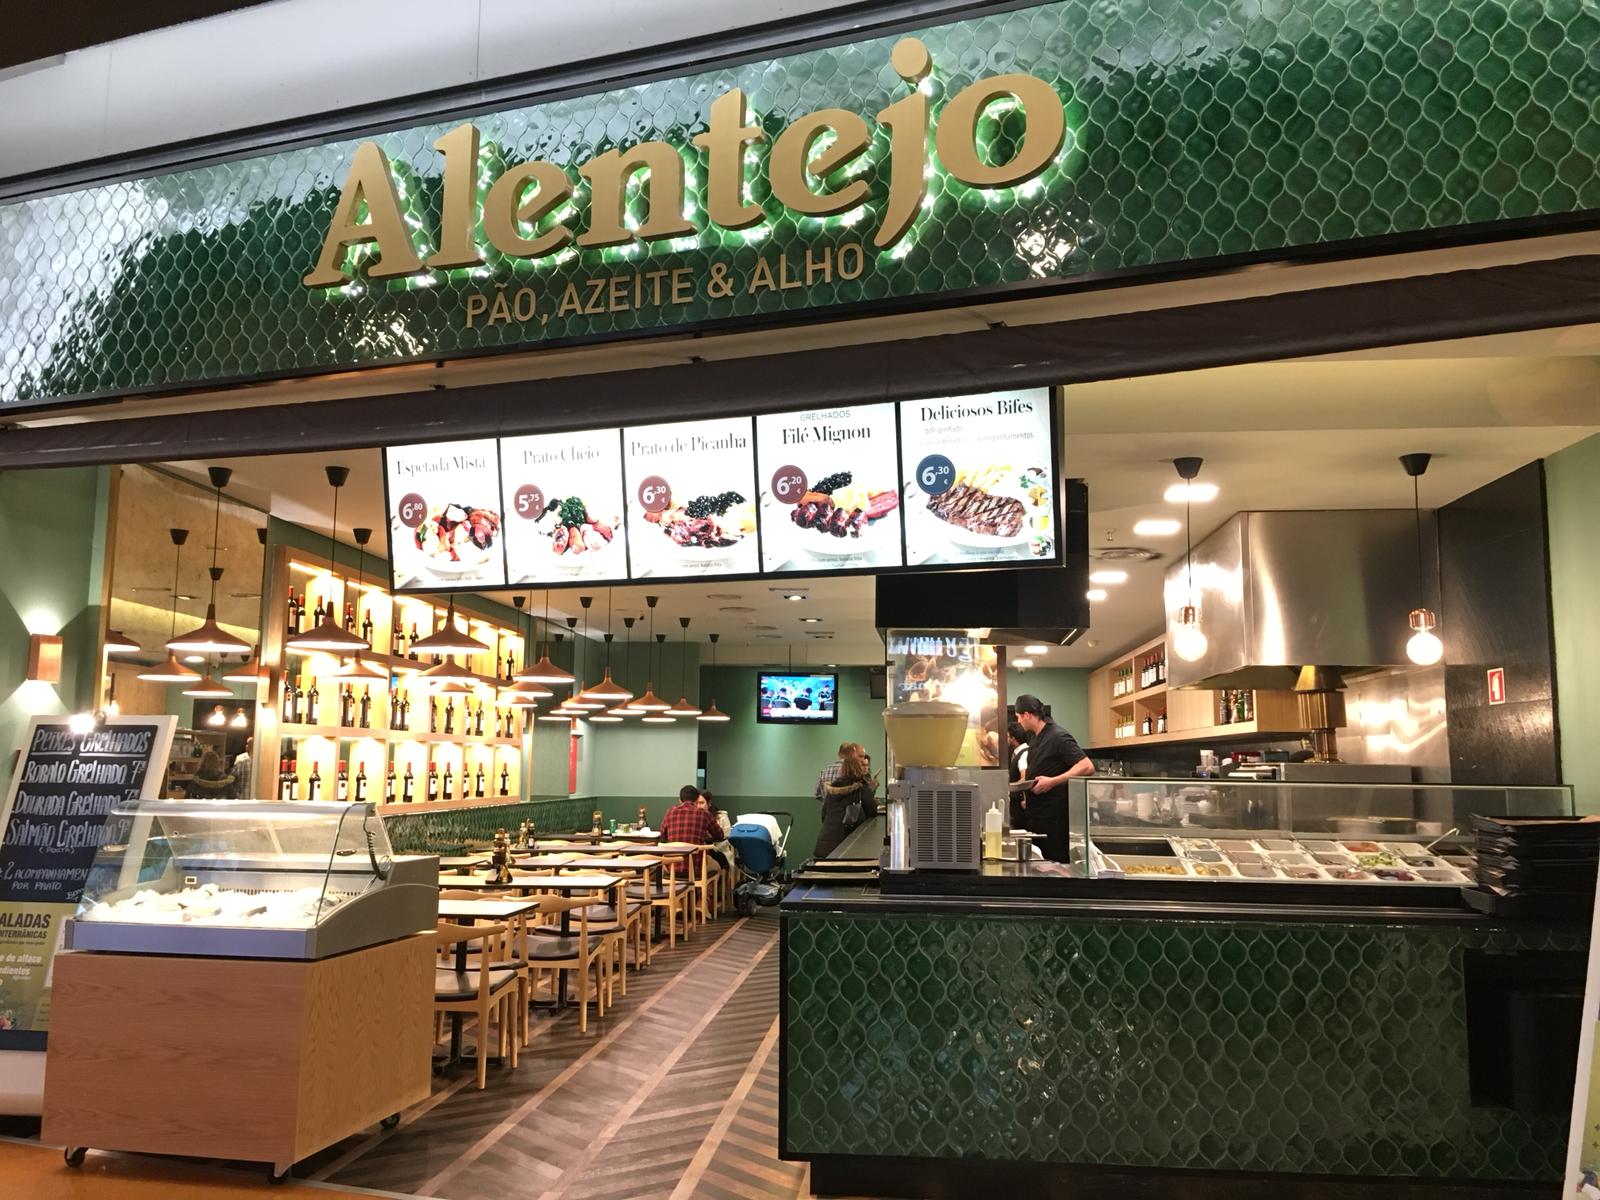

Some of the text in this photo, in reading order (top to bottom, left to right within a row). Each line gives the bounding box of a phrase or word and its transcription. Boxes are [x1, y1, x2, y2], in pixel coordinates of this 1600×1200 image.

[303, 37, 1066, 288] Alentejo
[466, 243, 864, 328] PÃO, AZEITE & ALHO
[800, 410, 851, 421] GRELHADOS
[920, 398, 1034, 422] Deliciosos Bifes
[631, 433, 747, 456] Prato de Picanha
[782, 425, 871, 446] Filé Mignon
[397, 456, 486, 478] Espetada Mista
[922, 466, 949, 485] 6,30
[642, 486, 666, 504] 6,30
[776, 476, 802, 495] 6,20
[518, 494, 540, 512] 5,75
[11, 881, 62, 890] POR PRATO
